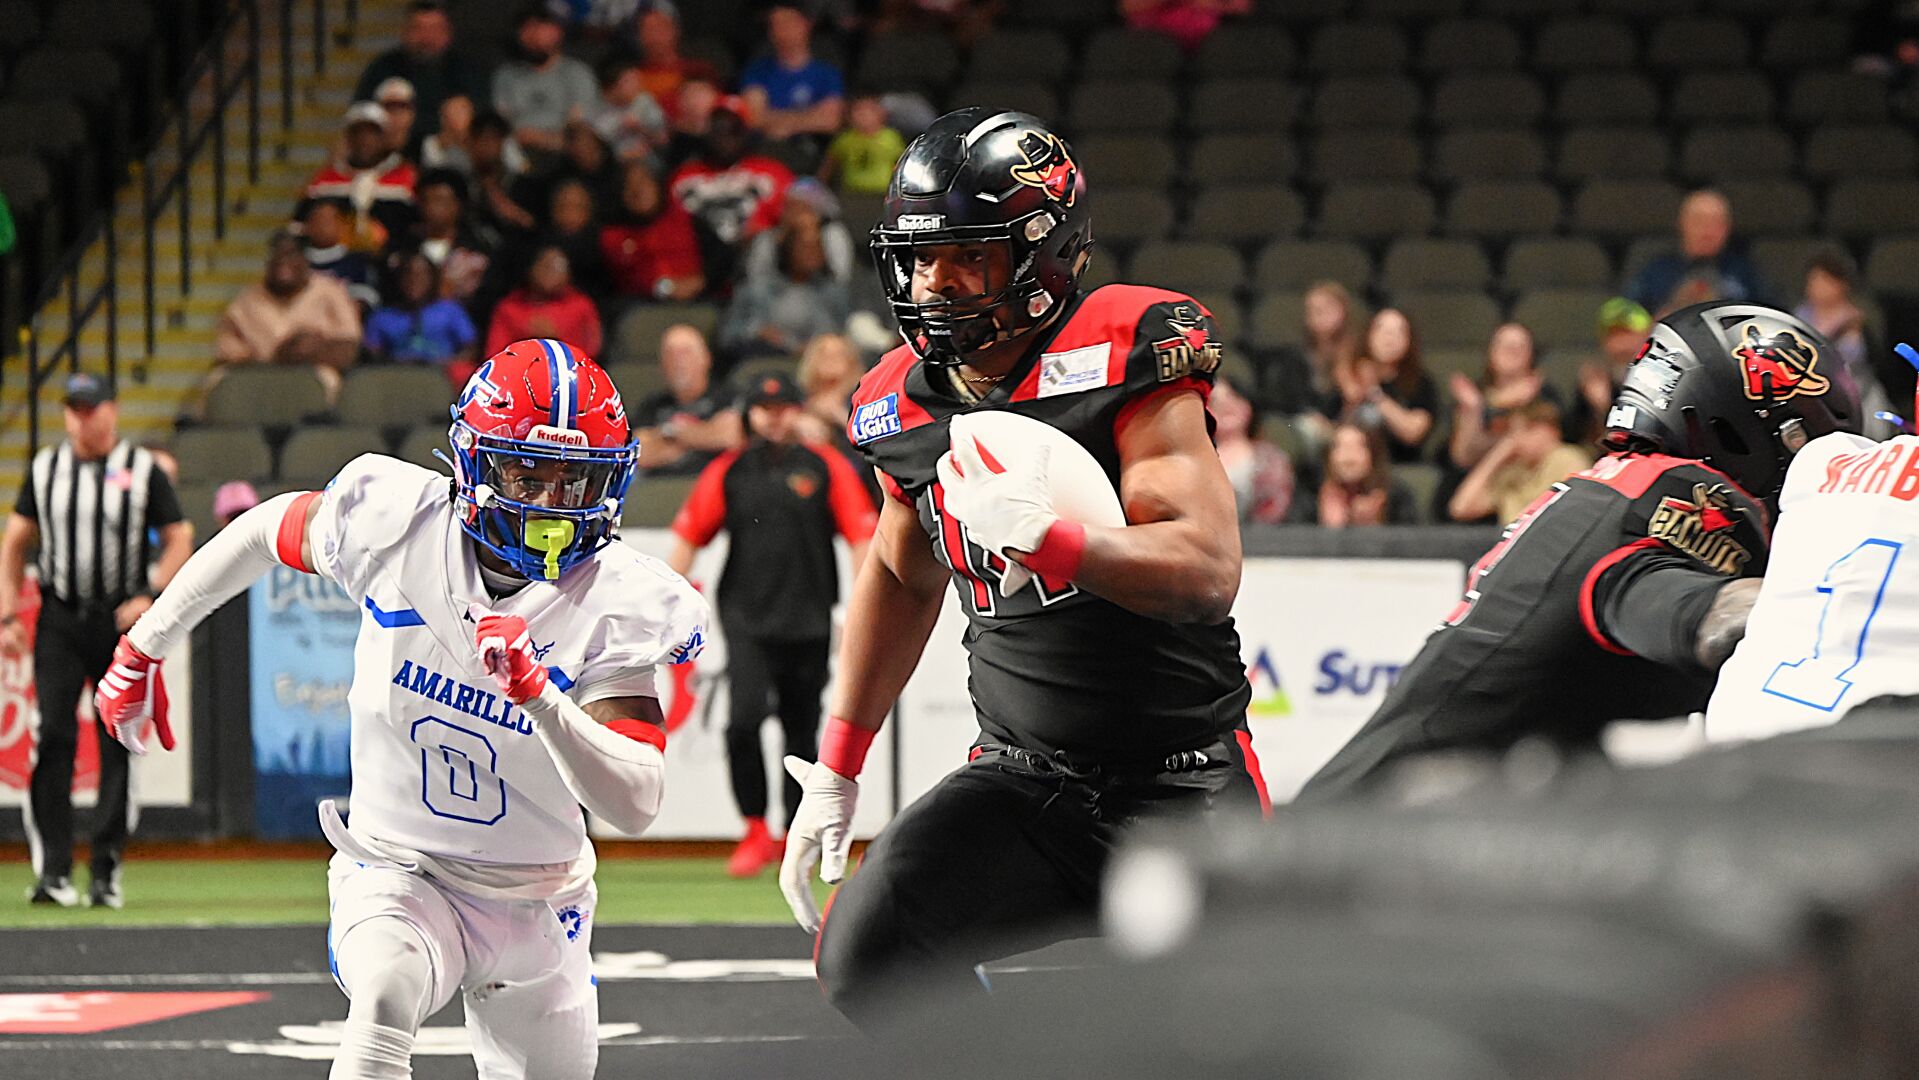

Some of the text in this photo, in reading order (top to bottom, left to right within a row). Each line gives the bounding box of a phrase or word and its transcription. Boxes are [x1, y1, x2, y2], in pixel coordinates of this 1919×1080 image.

[897, 216, 942, 231] Riddell
[859, 400, 889, 423] BUD
[536, 429, 584, 445] Riddell
[852, 414, 901, 440] LIGHT
[1761, 537, 1903, 713] 1
[410, 715, 507, 826] 0
